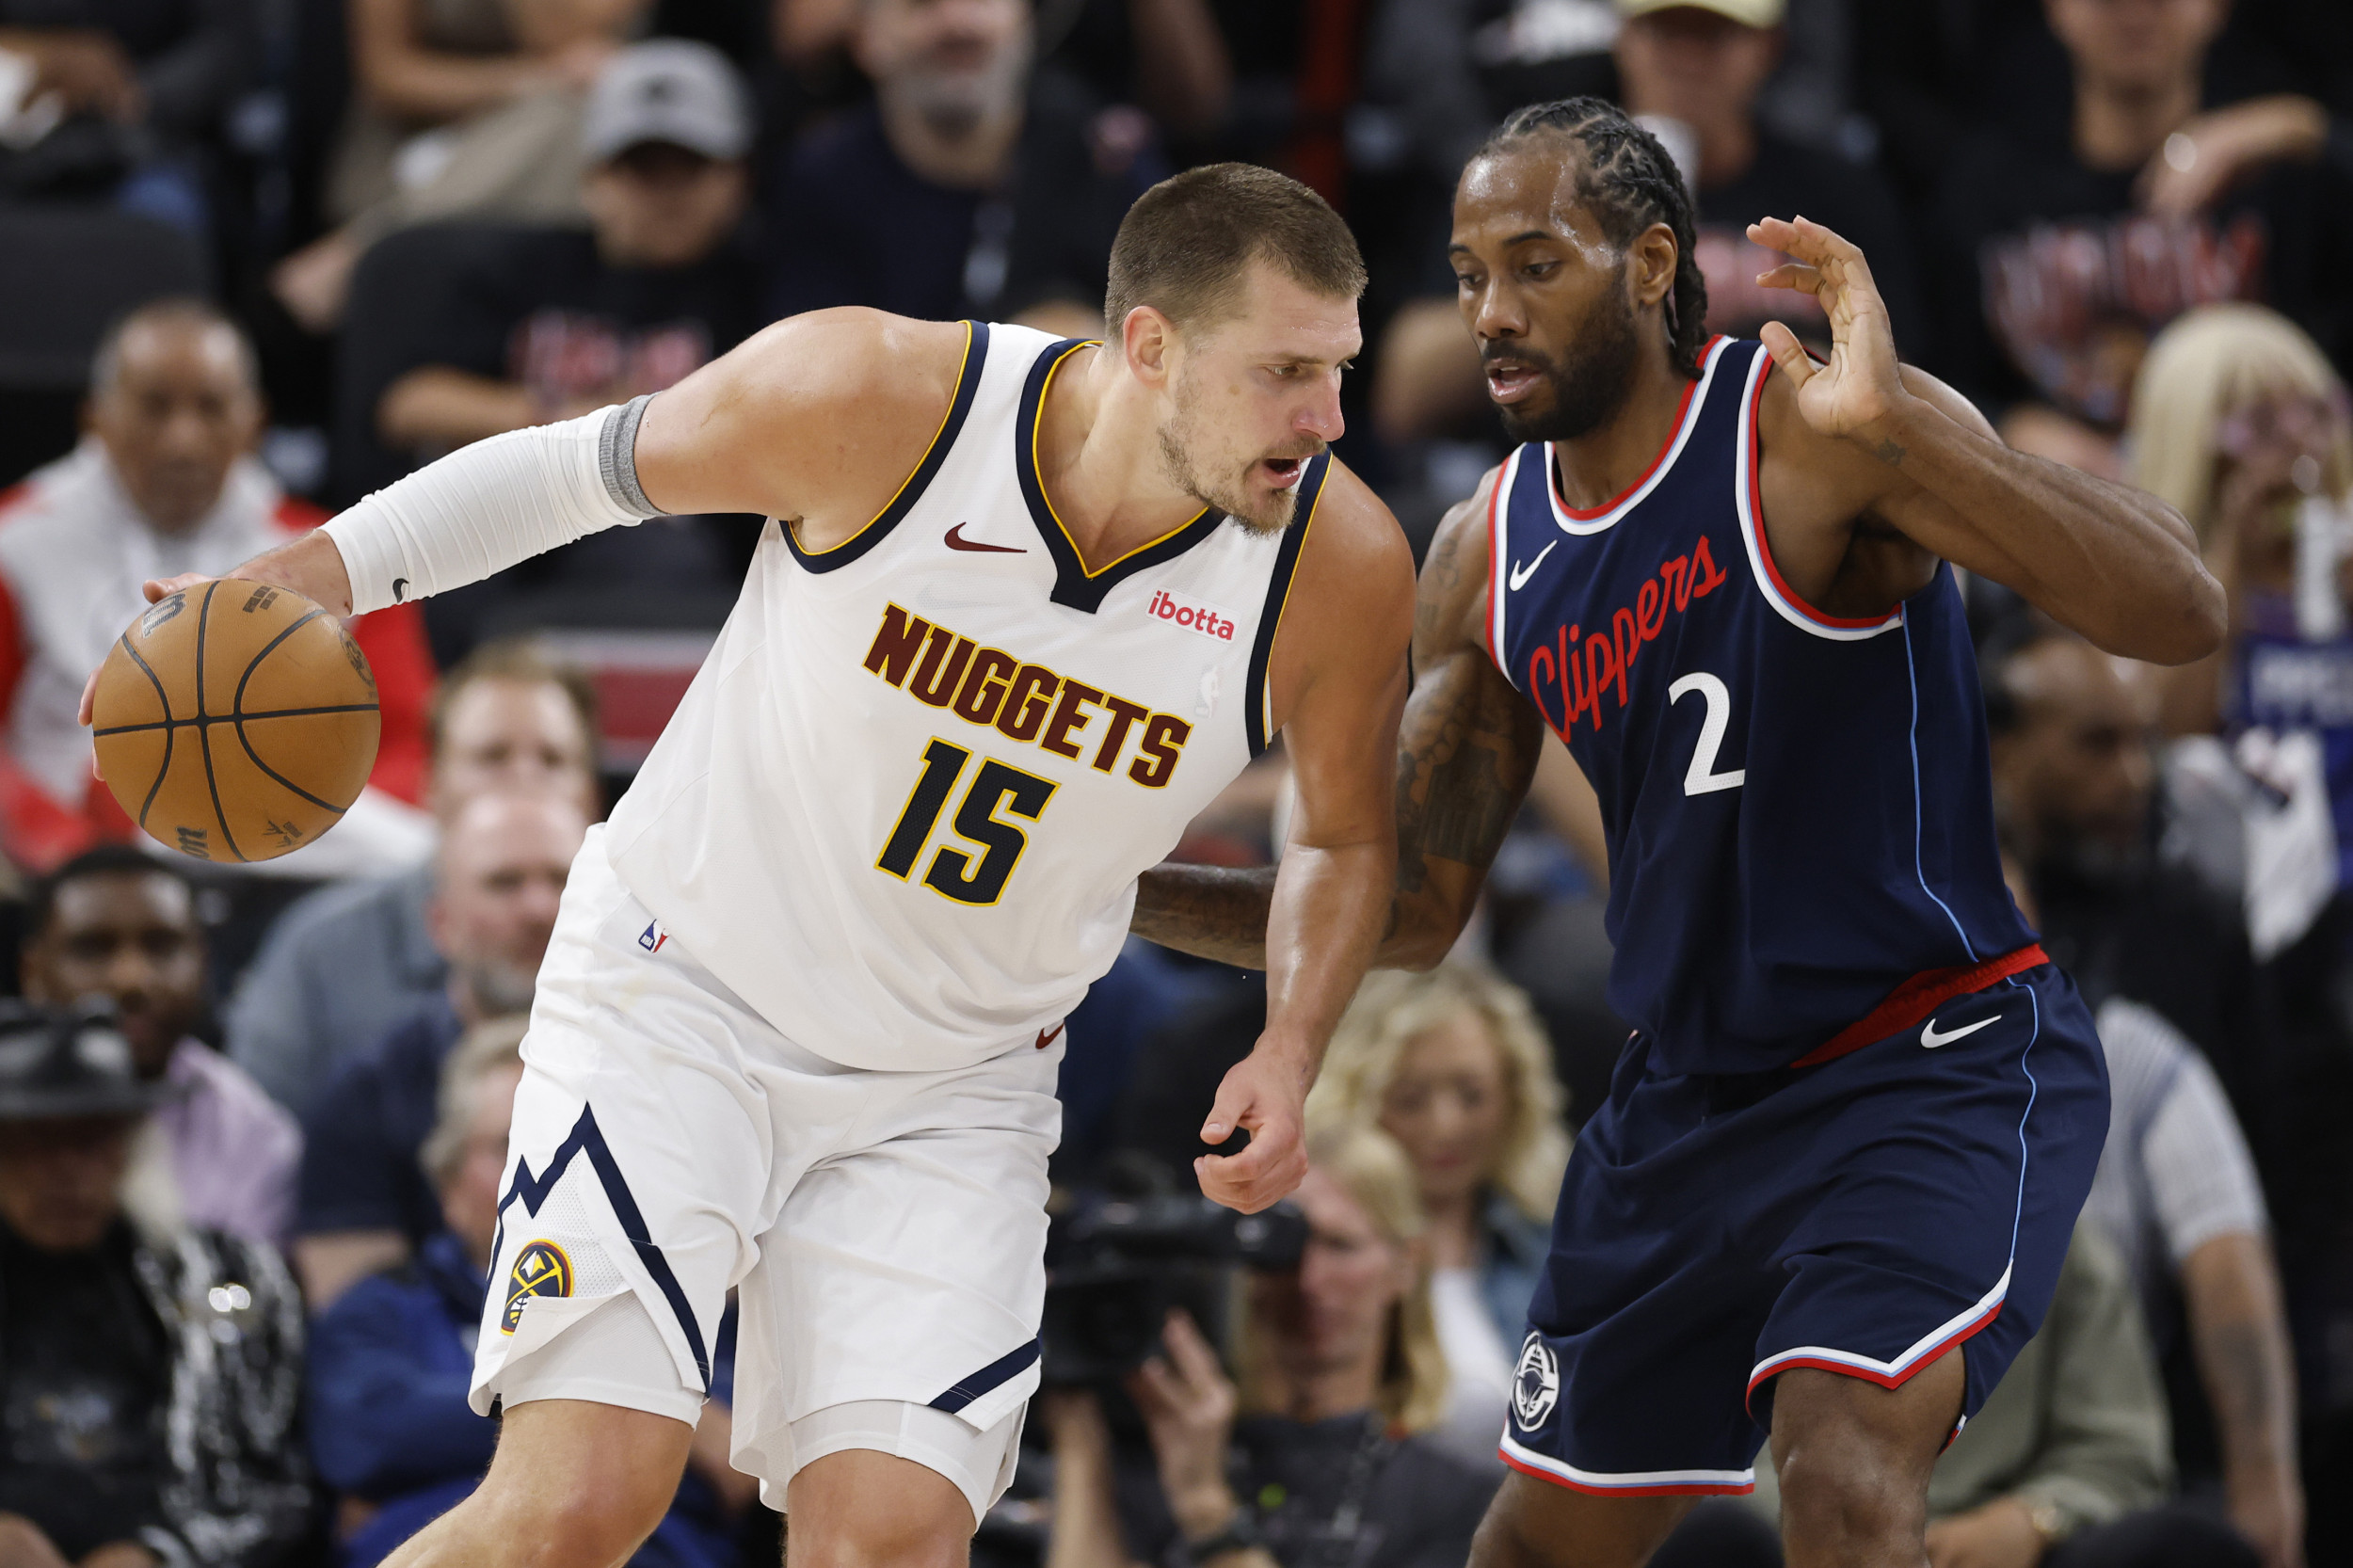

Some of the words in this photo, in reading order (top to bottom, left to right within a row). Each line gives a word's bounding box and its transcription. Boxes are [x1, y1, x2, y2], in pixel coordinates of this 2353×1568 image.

[862, 601, 1194, 789] NUGGETS
[1148, 590, 1235, 641] ibotta
[1529, 535, 1727, 744] Clippers
[1668, 672, 1746, 797] 2
[873, 735, 1062, 907] 15
